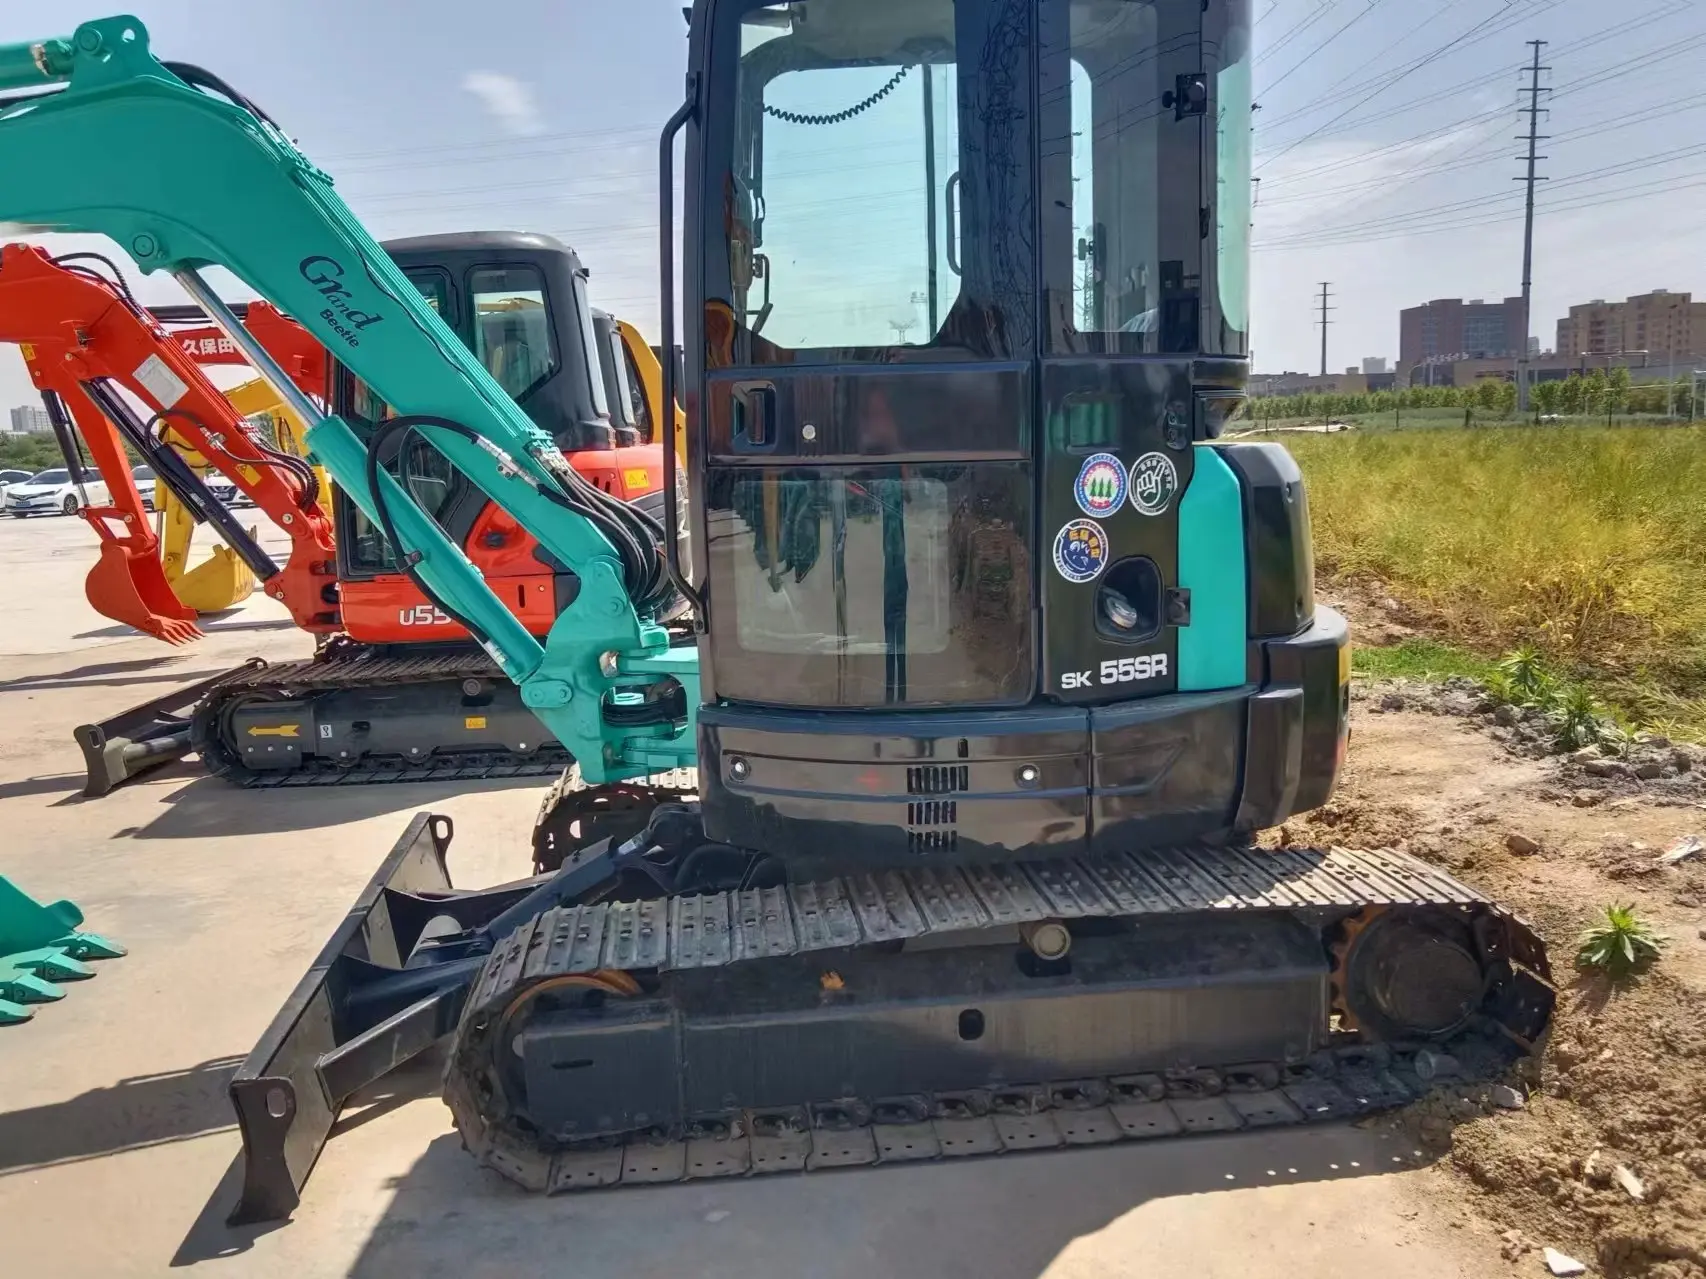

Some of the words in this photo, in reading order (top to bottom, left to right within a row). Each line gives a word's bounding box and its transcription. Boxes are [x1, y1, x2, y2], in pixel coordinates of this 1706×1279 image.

[299, 255, 385, 331] Grand
[182, 338, 235, 356] 久保田
[320, 308, 360, 348] Beetle
[1061, 669, 1093, 690] SK
[1100, 652, 1168, 685] 55SR
